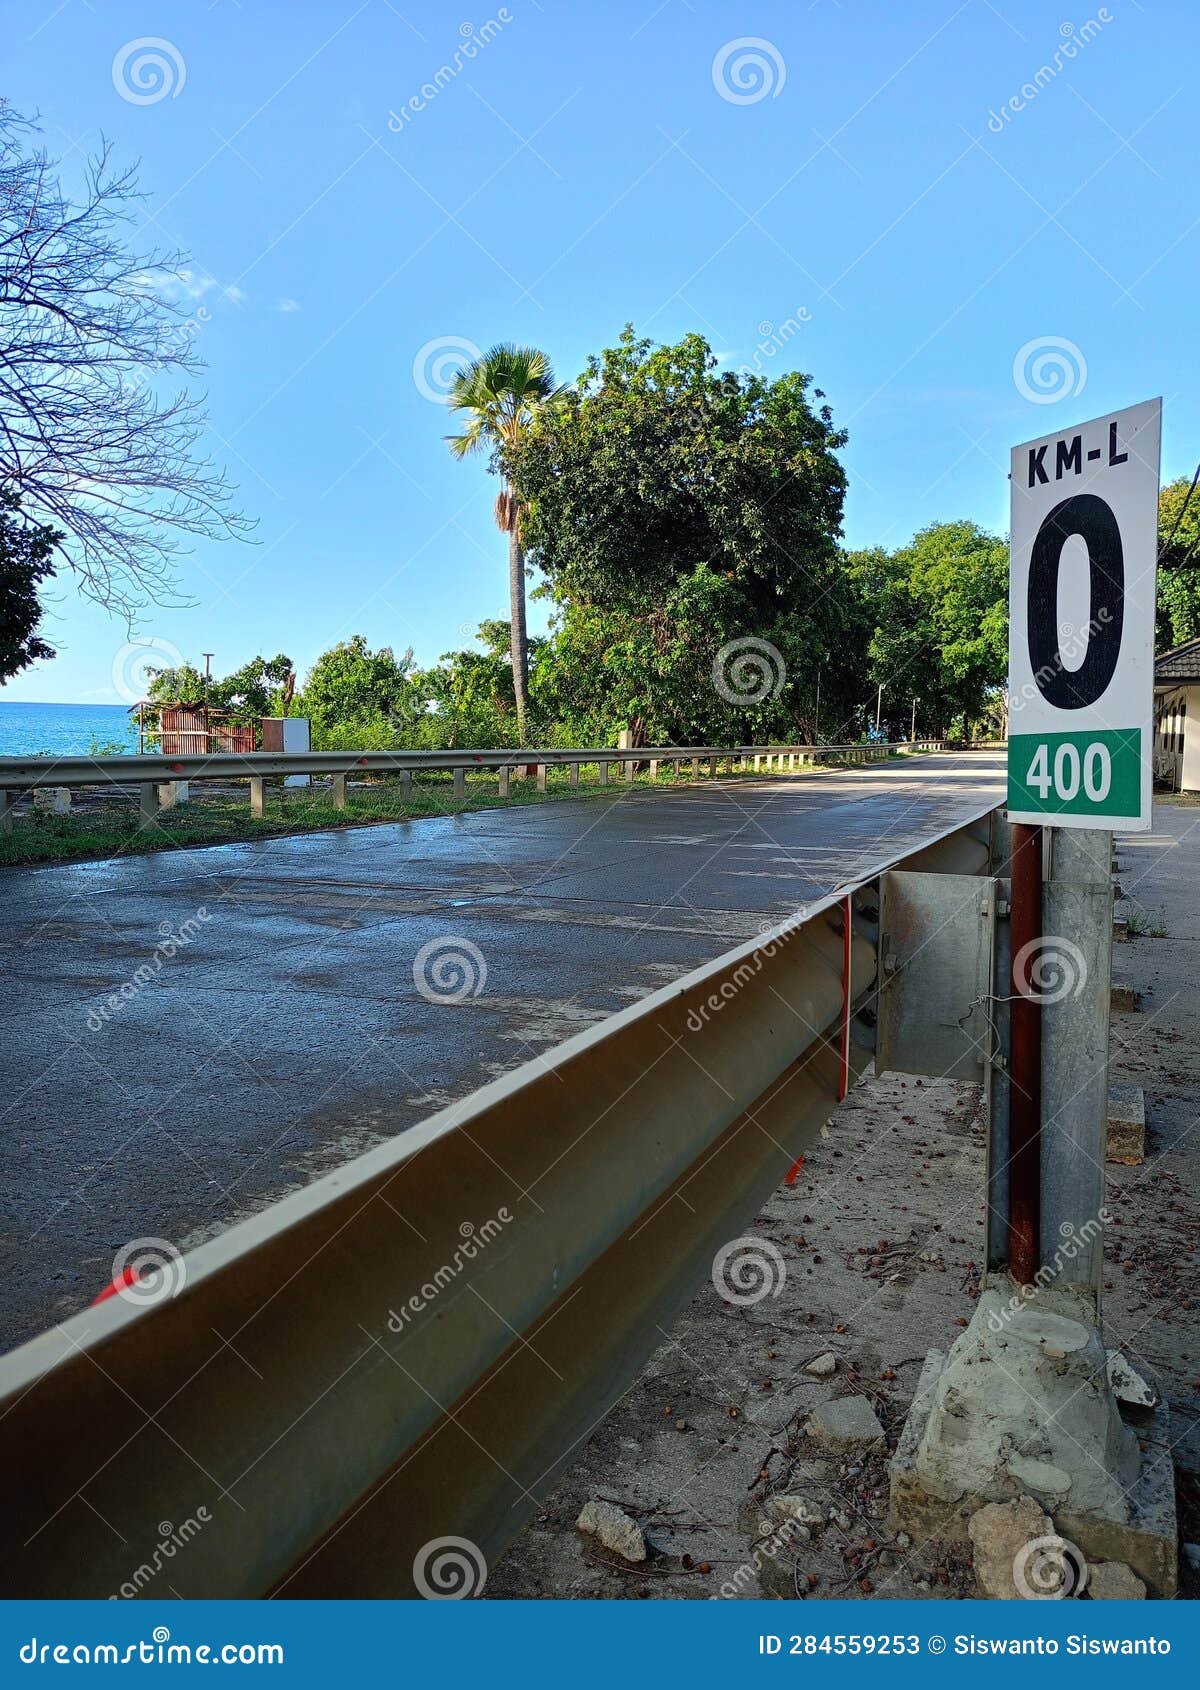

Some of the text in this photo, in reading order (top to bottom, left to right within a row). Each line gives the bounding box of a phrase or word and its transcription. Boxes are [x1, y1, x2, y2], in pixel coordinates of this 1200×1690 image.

[1027, 421, 1129, 488] KM-L
[1027, 493, 1125, 710] 0
[1026, 743, 1112, 802] 400
